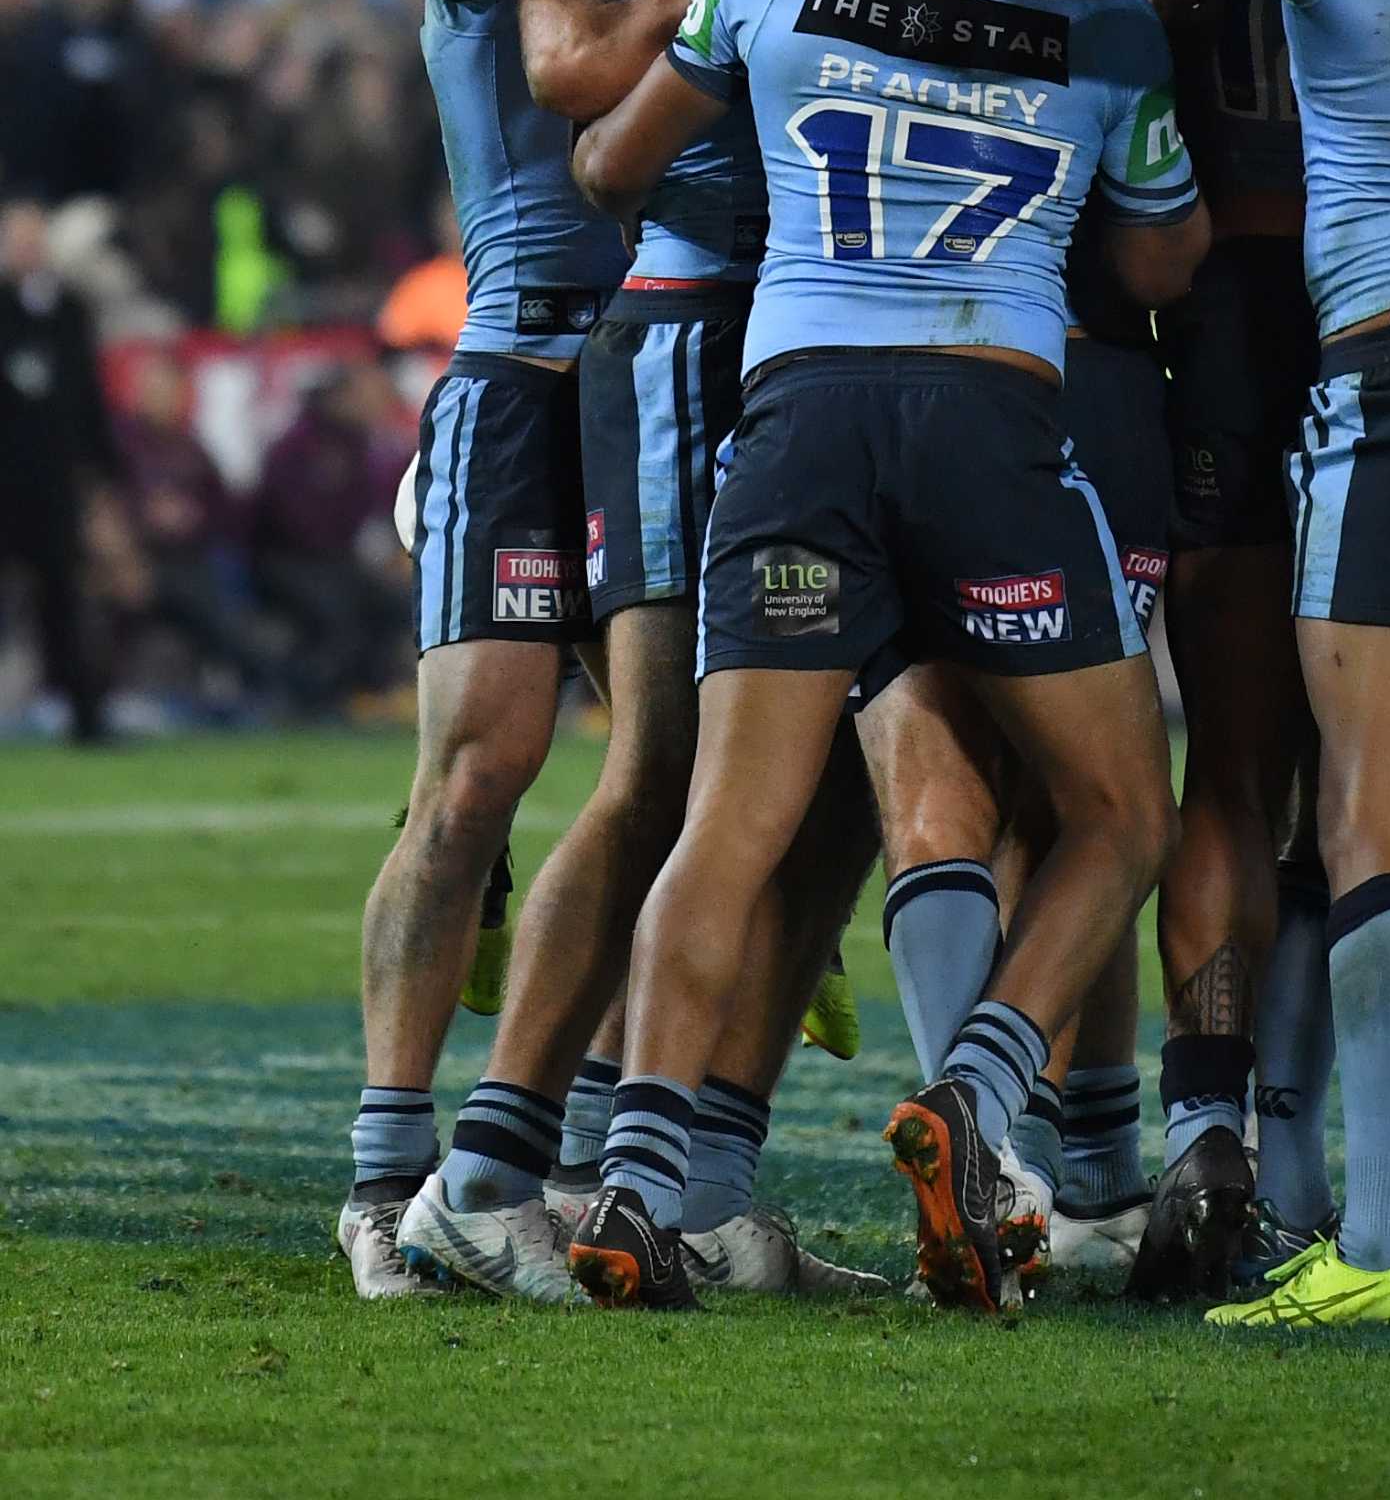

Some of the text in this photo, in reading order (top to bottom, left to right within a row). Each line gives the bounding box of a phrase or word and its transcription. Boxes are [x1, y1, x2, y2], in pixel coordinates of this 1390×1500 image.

[952, 20, 1063, 61] STAR
[818, 52, 1048, 126] PEACHEY
[785, 98, 1075, 262] 17
[762, 564, 828, 590] une
[969, 580, 1052, 605] TOOHEYS
[764, 594, 825, 606] University of
[764, 606, 827, 619] New England
[966, 607, 1064, 641] NEW
[592, 1189, 617, 1235] TIEMPO
